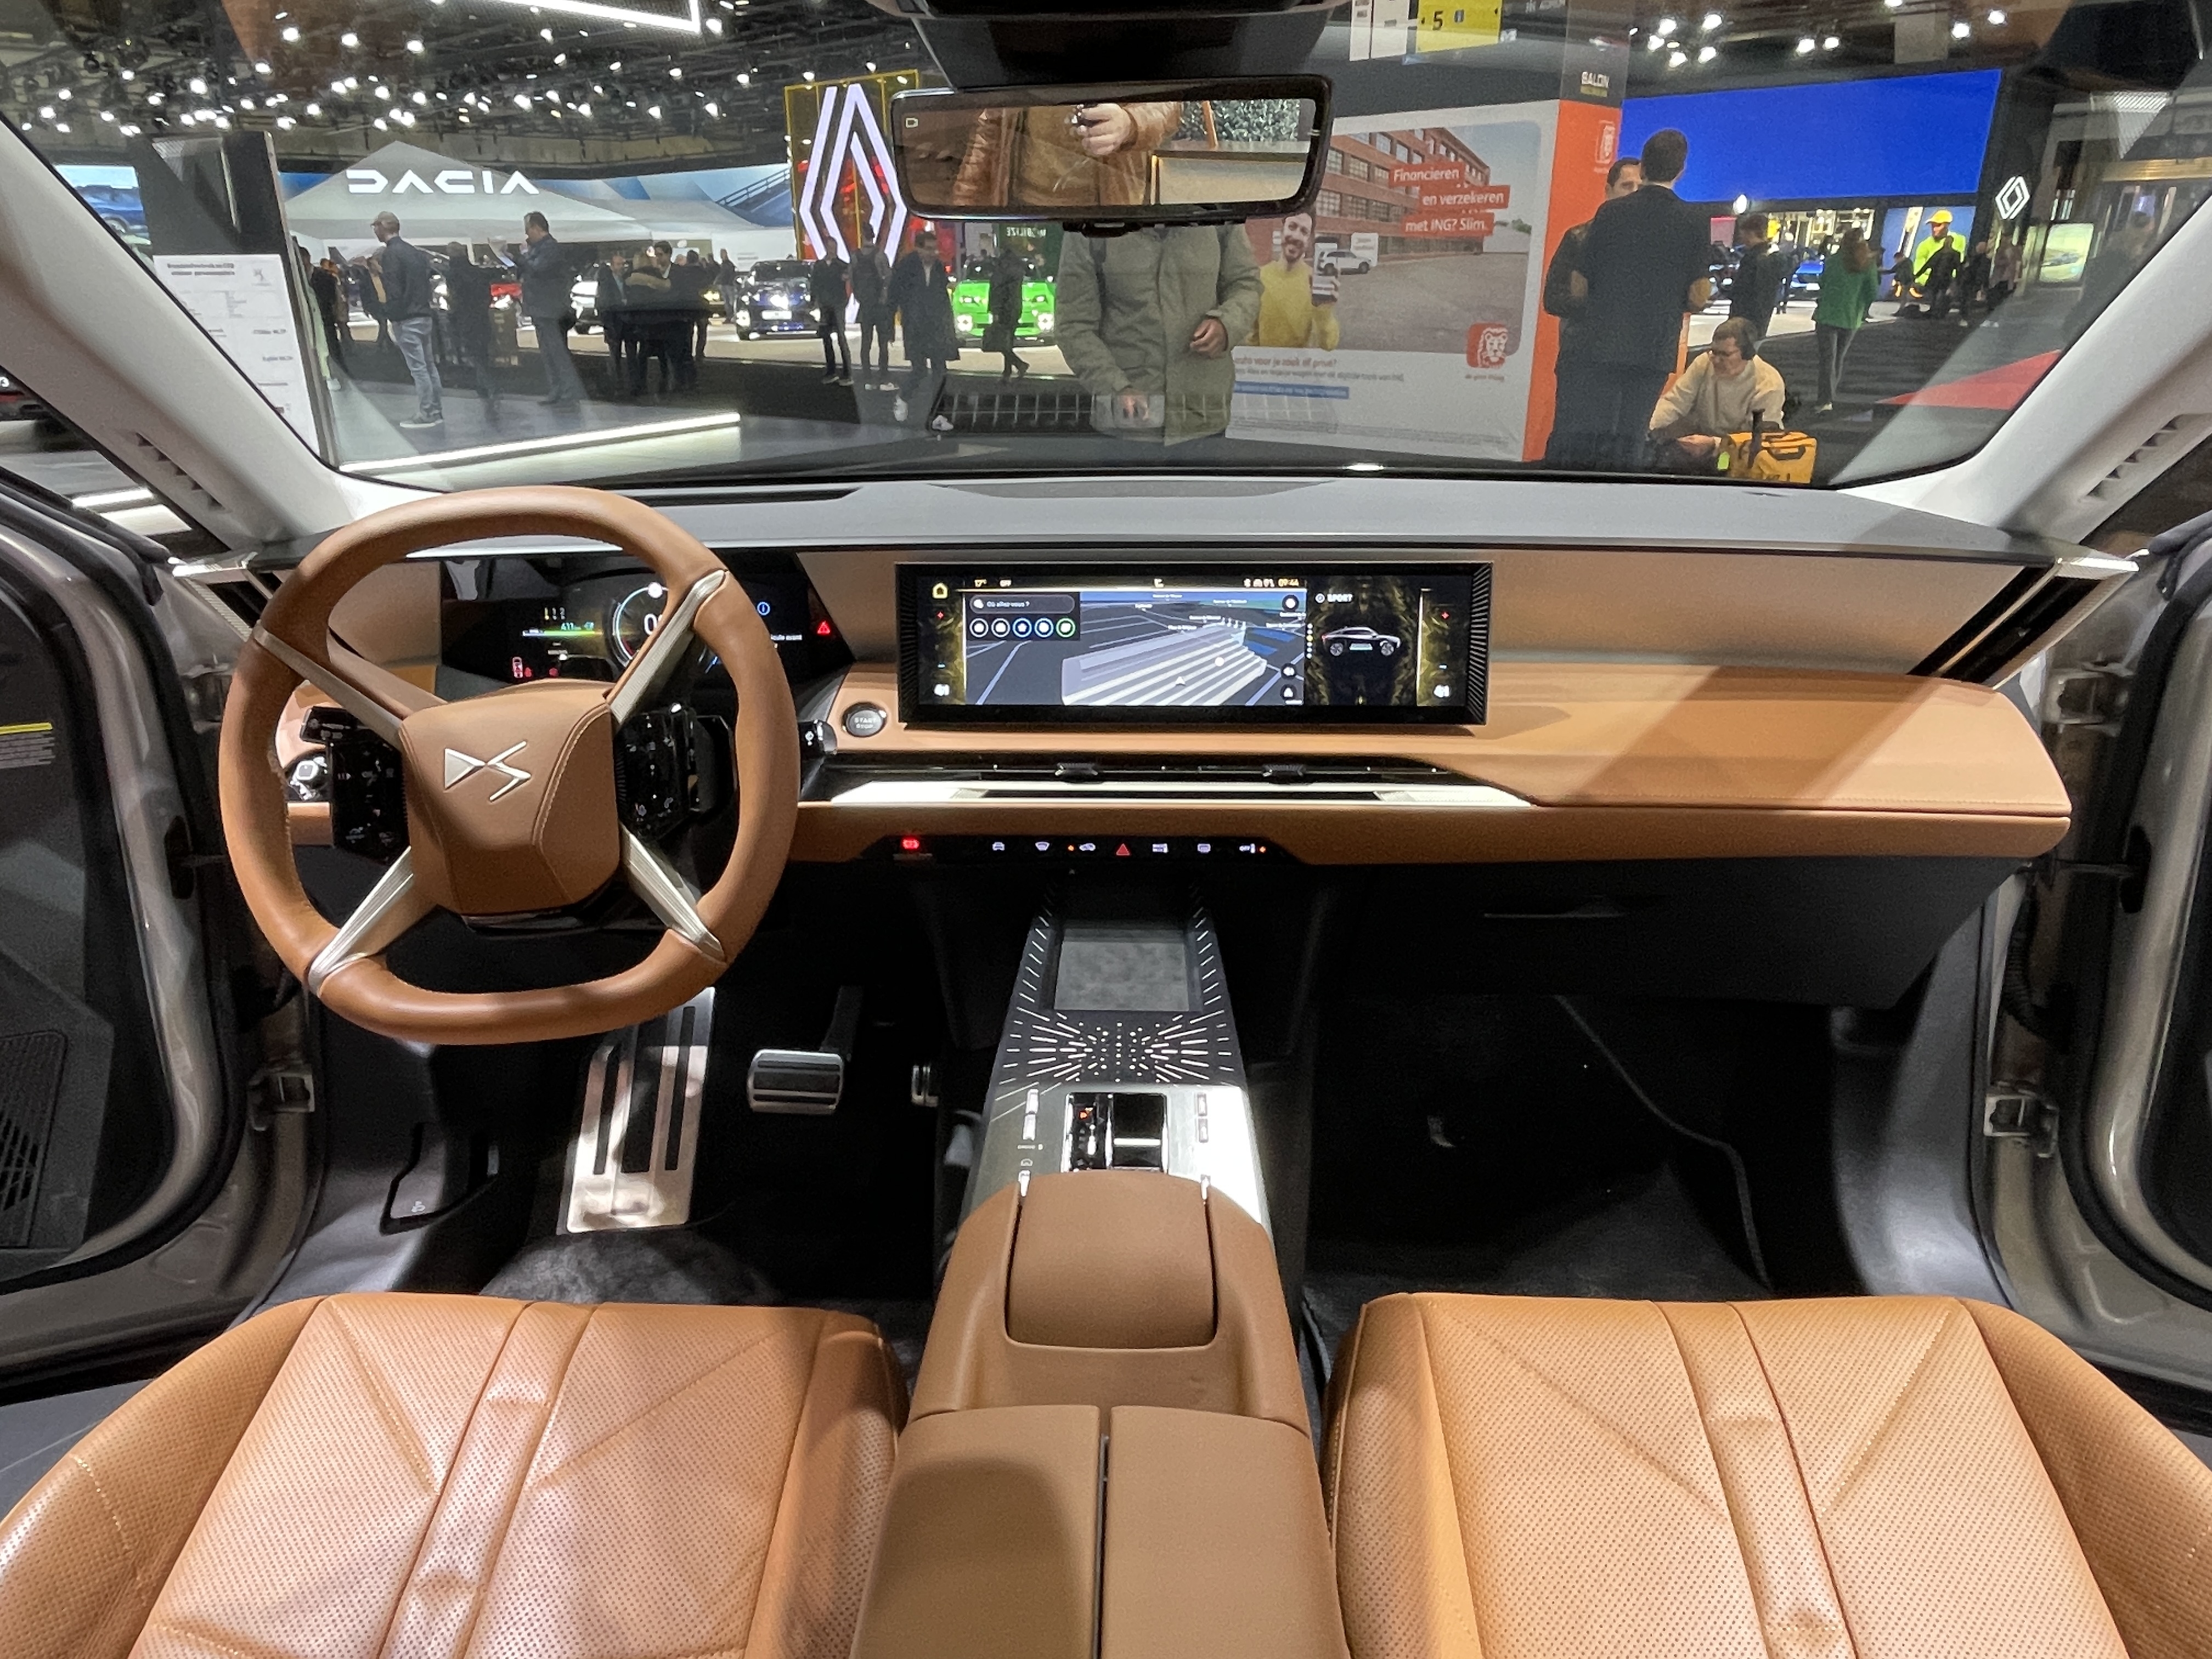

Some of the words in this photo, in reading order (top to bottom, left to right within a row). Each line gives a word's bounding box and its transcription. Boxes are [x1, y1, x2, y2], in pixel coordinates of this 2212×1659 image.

[346, 169, 539, 194] DACIA
[1393, 166, 1459, 182] Financieren
[1422, 195, 1437, 206] en
[1440, 190, 1504, 205] verzekeren
[1405, 220, 1428, 233] met
